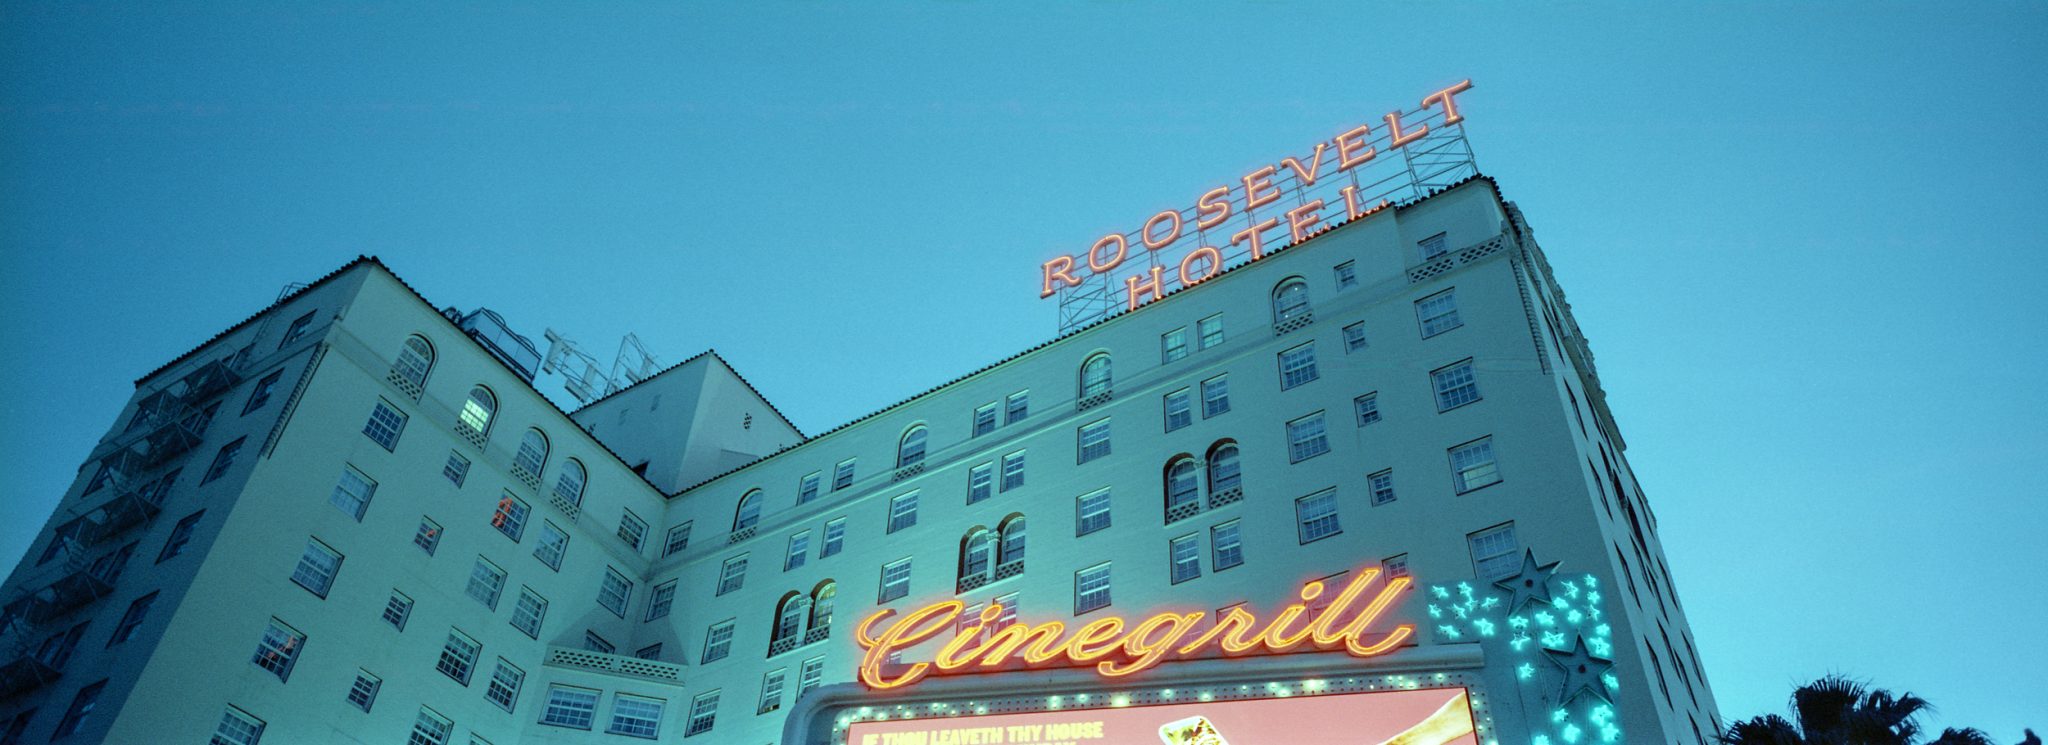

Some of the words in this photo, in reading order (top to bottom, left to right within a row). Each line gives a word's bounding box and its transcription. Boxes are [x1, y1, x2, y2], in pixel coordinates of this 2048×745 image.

[1040, 78, 1472, 298] ROOSEVELT
[1126, 185, 1388, 312] HOTEL
[857, 567, 1415, 690] Cinegrill
[881, 730, 928, 745] THOU
[930, 726, 1003, 745] LEAVETH
[1006, 724, 1043, 744] THY
[1045, 721, 1104, 741] HOUSE
